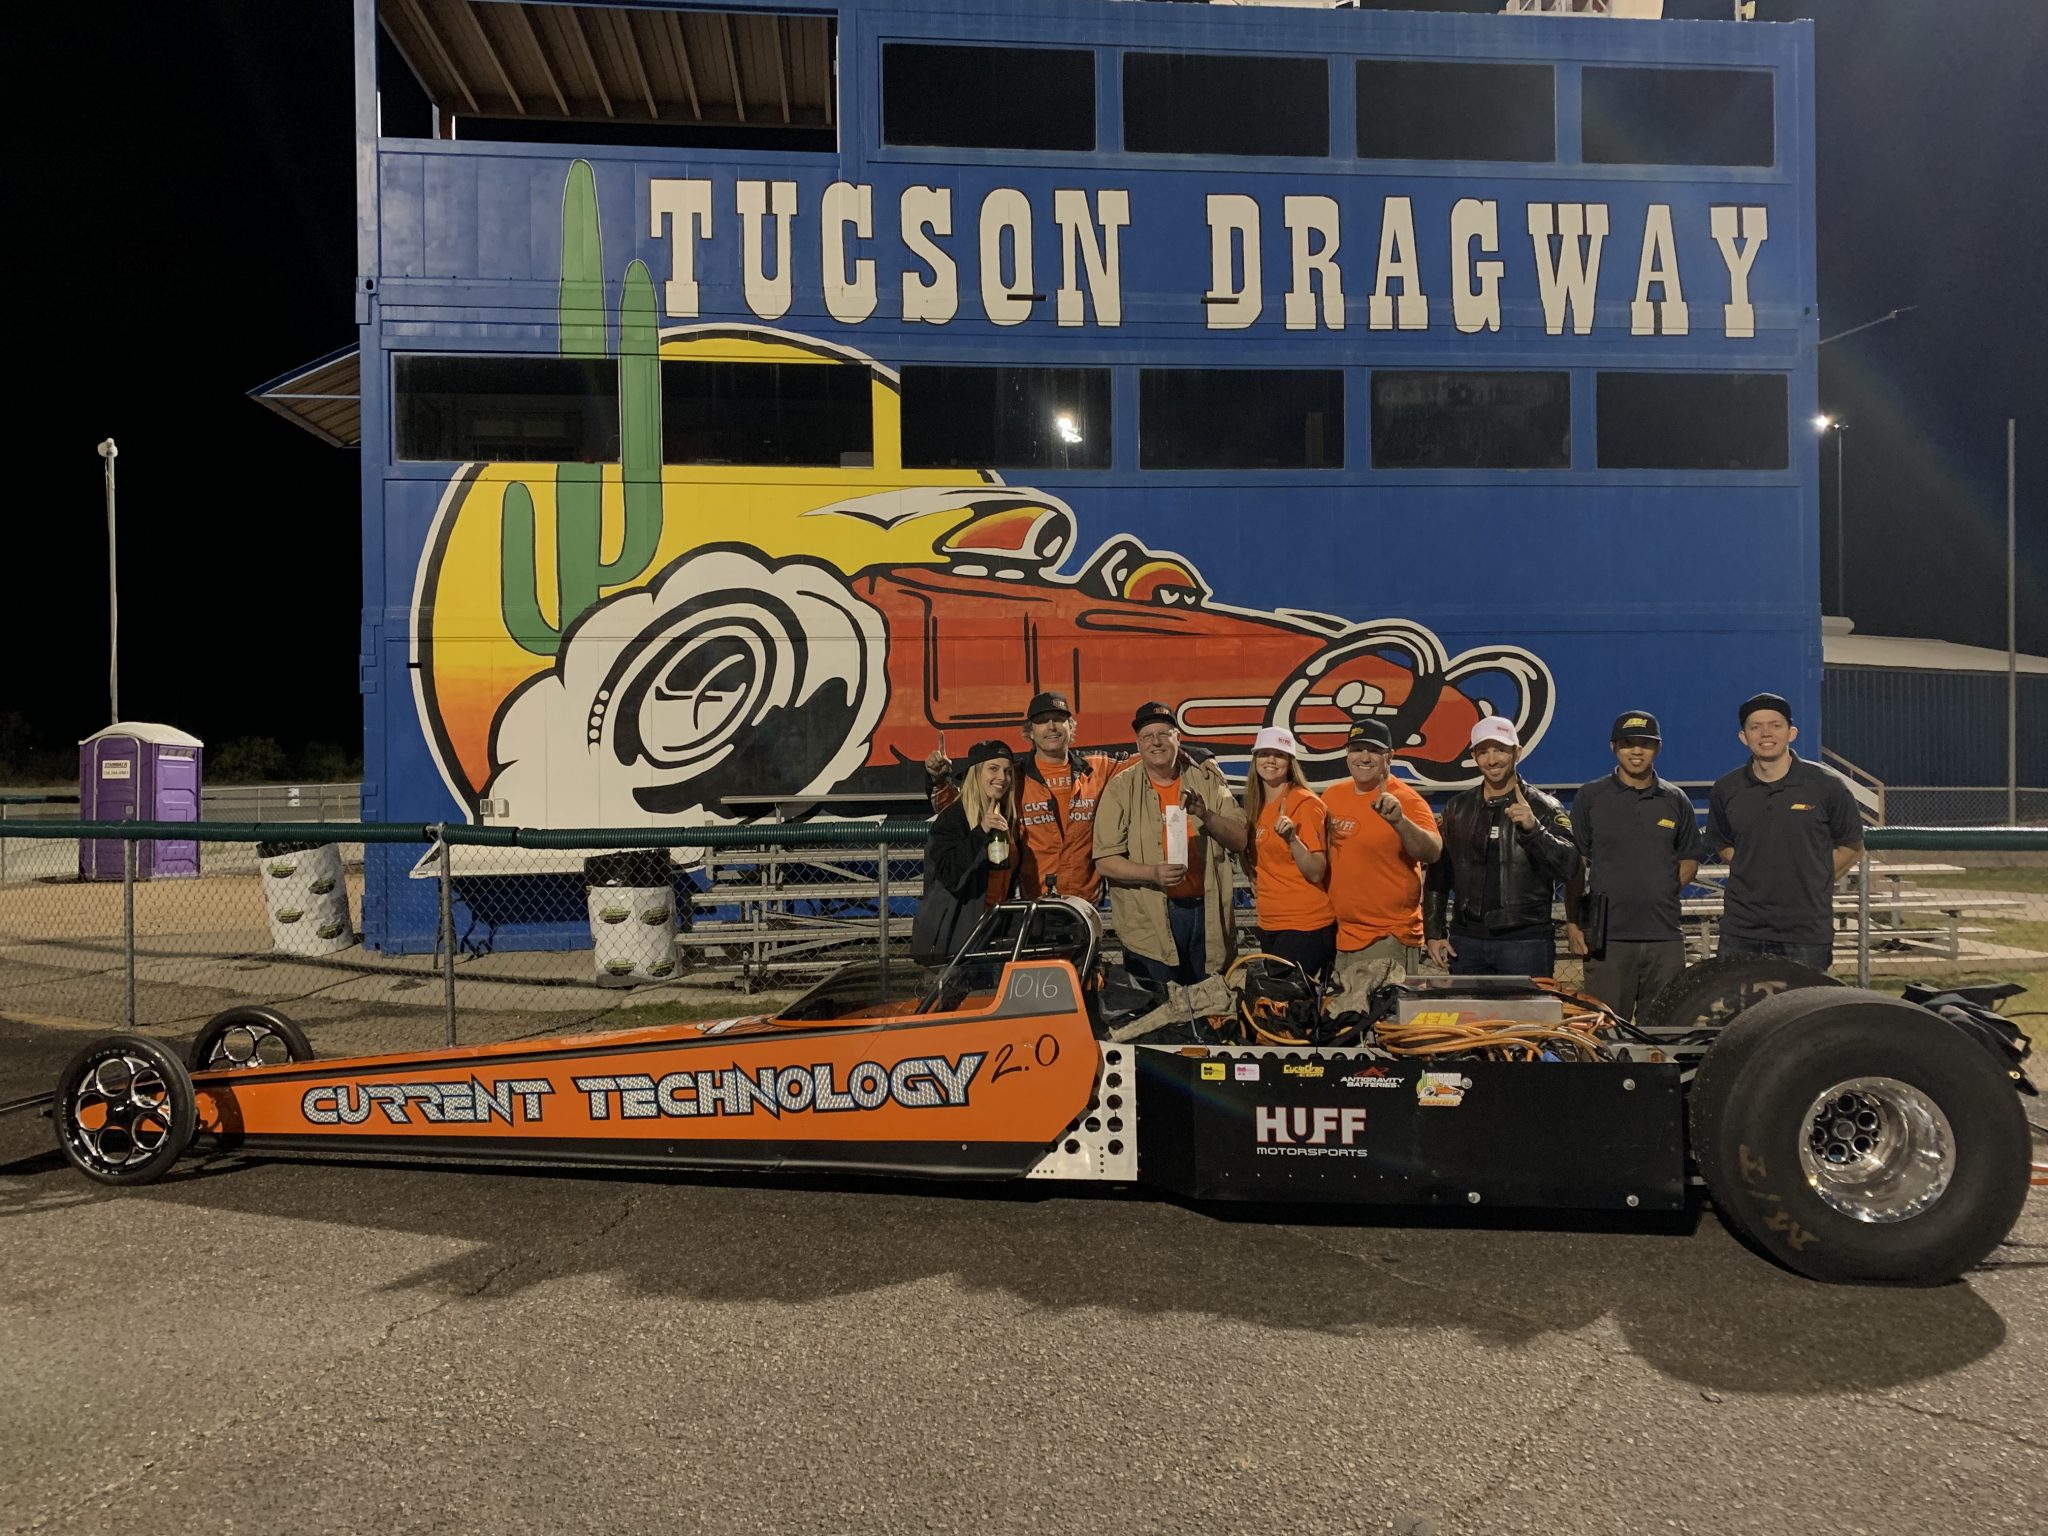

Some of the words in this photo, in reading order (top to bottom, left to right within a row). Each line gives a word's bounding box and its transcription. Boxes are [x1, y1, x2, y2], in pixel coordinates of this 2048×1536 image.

[650, 178, 1132, 328] TUCSON
[1205, 193, 1770, 339] DRAGWAY
[1008, 972, 1059, 1000] 1016
[301, 1073, 558, 1127] CURRENT
[572, 1050, 989, 1121] TECHNOLOGY
[991, 1033, 1061, 1084] 2.0
[1255, 1106, 1367, 1145] HUFF
[1256, 1147, 1369, 1157] MOTORSPORTS
